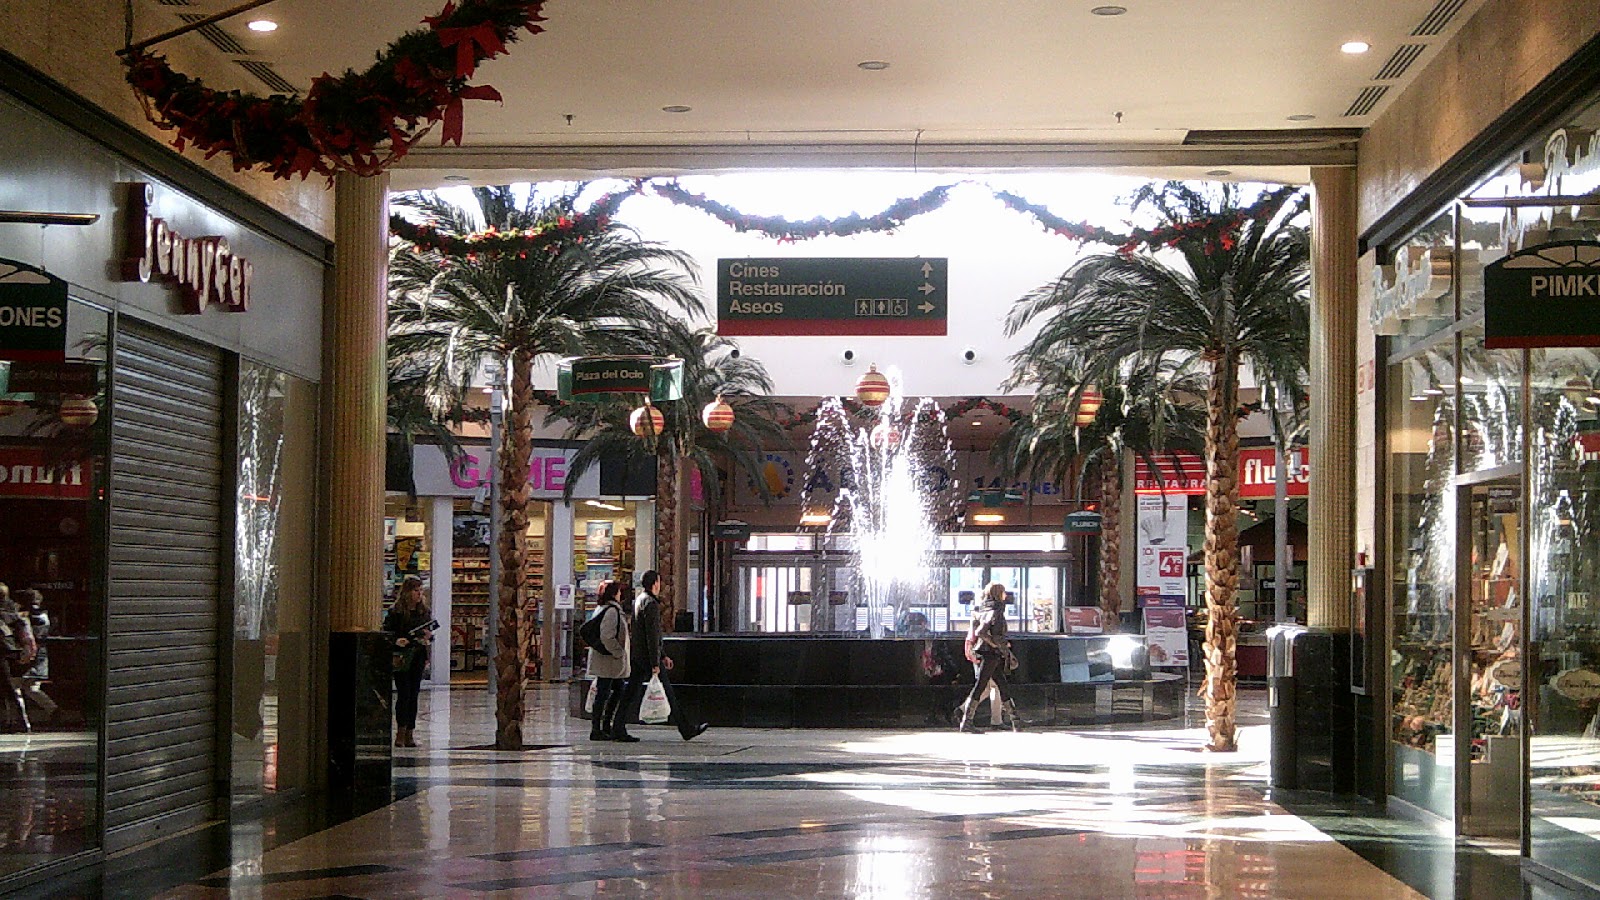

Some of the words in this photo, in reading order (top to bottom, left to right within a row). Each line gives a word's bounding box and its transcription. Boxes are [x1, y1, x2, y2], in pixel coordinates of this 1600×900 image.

[729, 262, 780, 278] Cines
[729, 280, 846, 296] Restauración
[1531, 275, 1600, 296] PIMK
[729, 299, 784, 314] Aseos
[0, 306, 62, 328] ONES
[576, 371, 600, 380] Plaza
[602, 369, 618, 379] del
[620, 369, 644, 379] Ocio
[450, 455, 566, 490] GME
